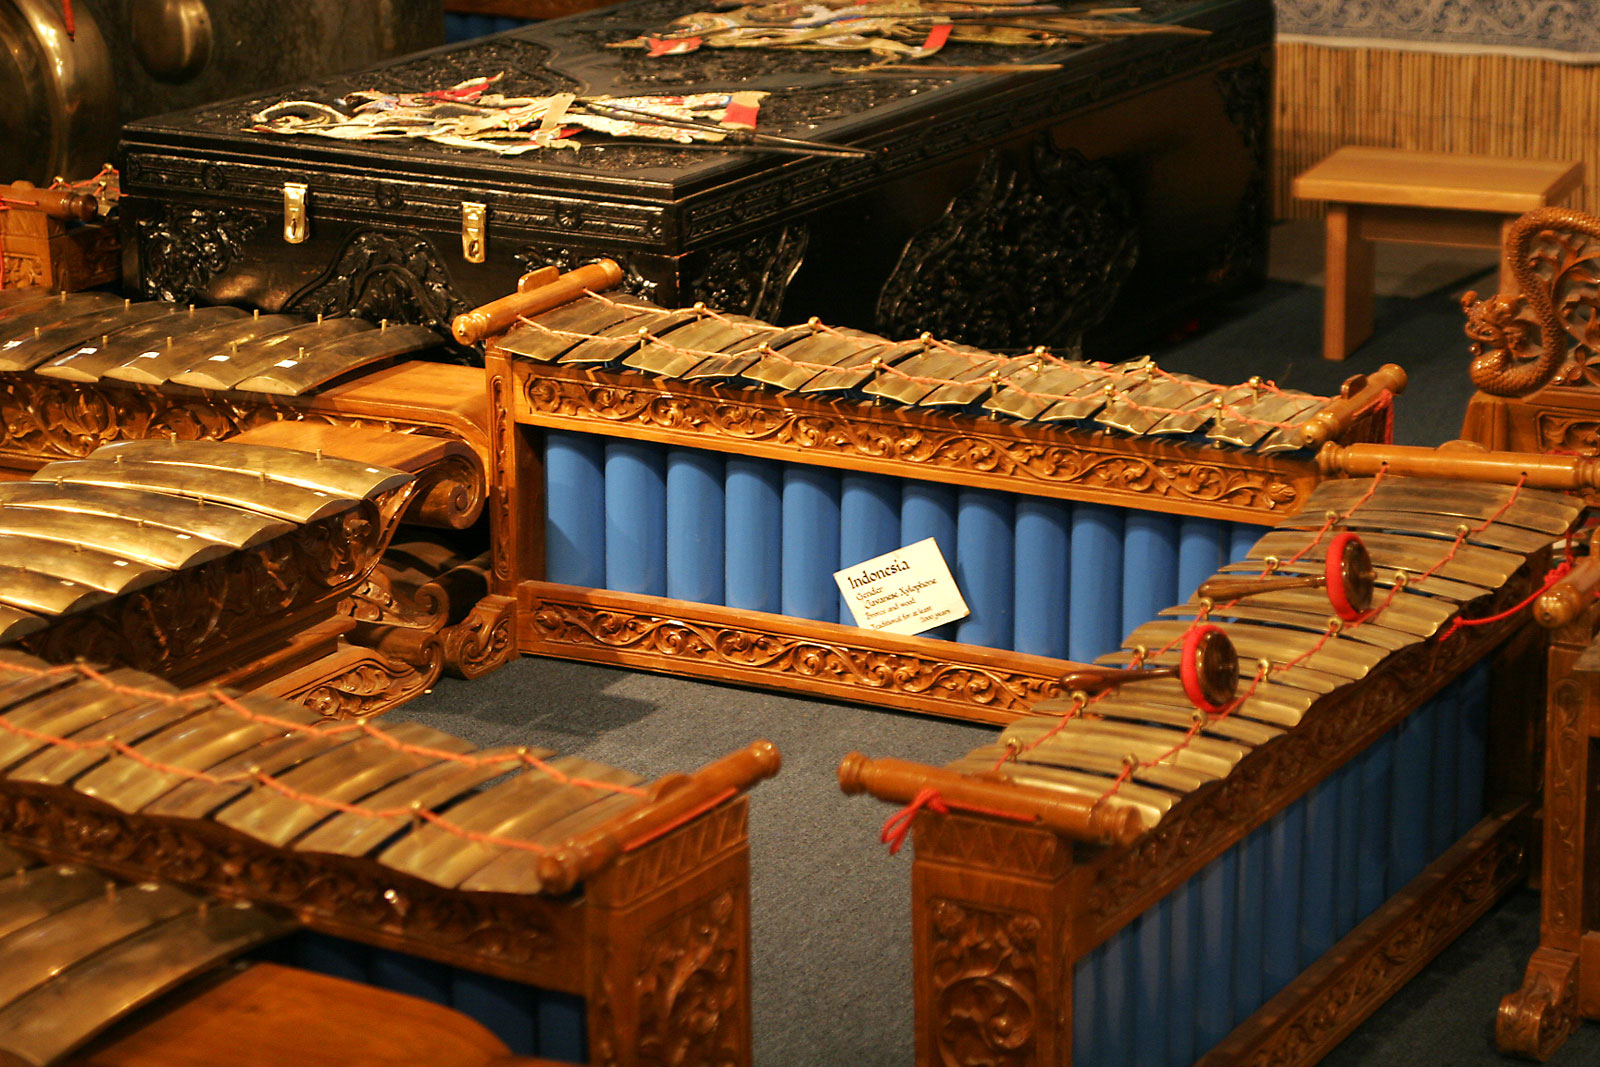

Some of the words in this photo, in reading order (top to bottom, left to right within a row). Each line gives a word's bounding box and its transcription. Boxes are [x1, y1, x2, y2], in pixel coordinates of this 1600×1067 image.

[847, 559, 910, 589] Indonesia
[856, 587, 883, 601] Gender
[864, 592, 899, 609] Javanese
[899, 578, 937, 597] Xylophone
[888, 603, 899, 612] and
[900, 597, 917, 608] wood
[902, 611, 911, 620] for
